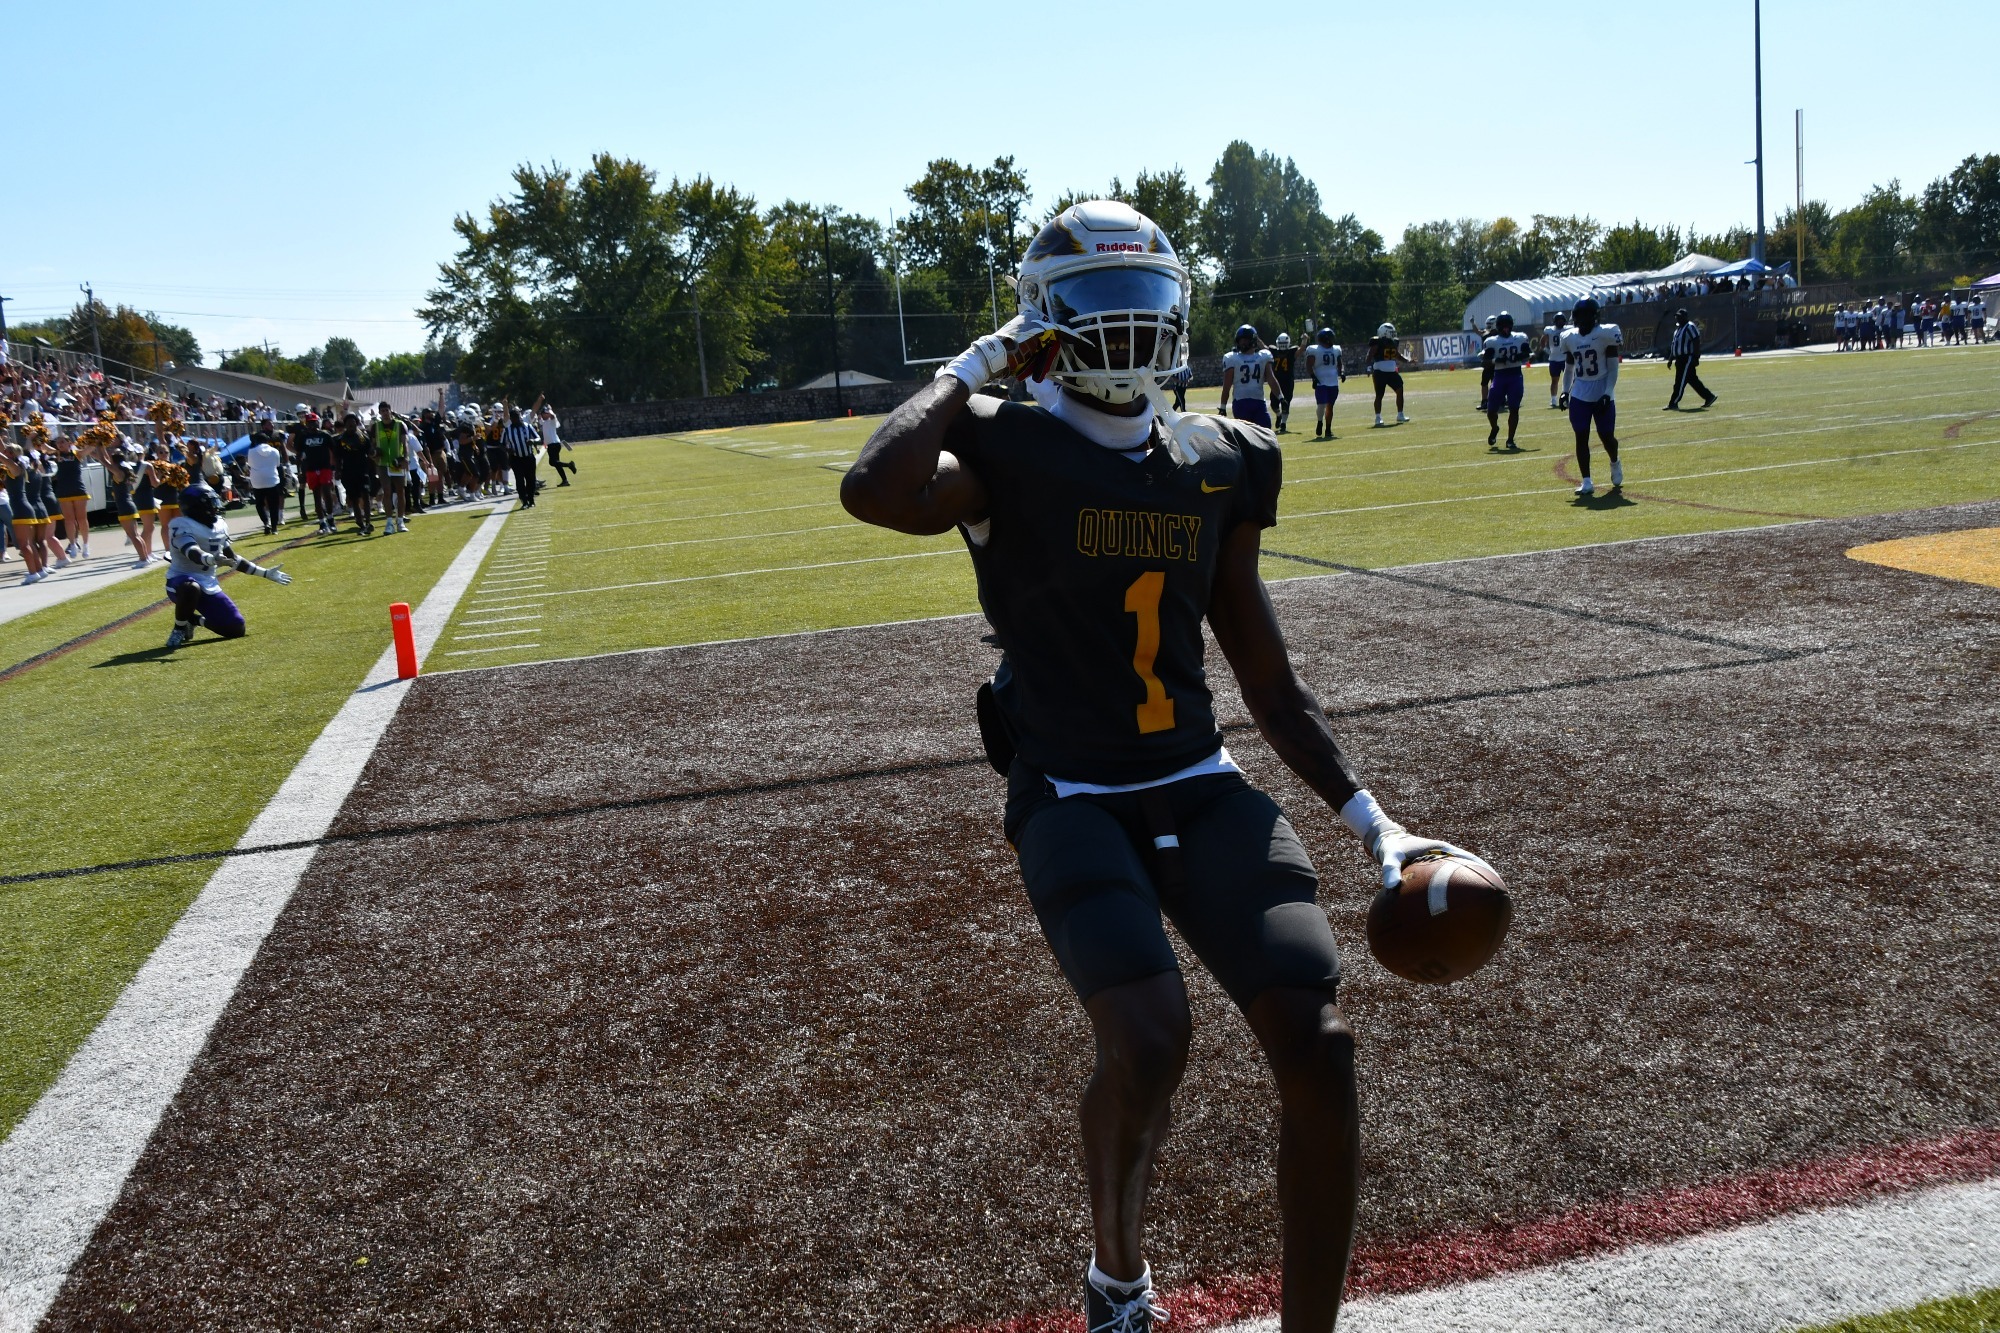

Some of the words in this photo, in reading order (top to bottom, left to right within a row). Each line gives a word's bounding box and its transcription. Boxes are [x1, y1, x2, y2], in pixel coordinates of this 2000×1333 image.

[1096, 242, 1143, 252] Riddell
[1781, 302, 1837, 320] HOME
[1383, 348, 1397, 360] 52
[1424, 335, 1470, 357] WGEM
[1275, 357, 1288, 371] 74
[1323, 353, 1335, 366] 91
[1573, 349, 1599, 377] 33
[1240, 363, 1261, 384] 34
[1077, 508, 1201, 561] QUINCY
[1124, 571, 1175, 734] 1
